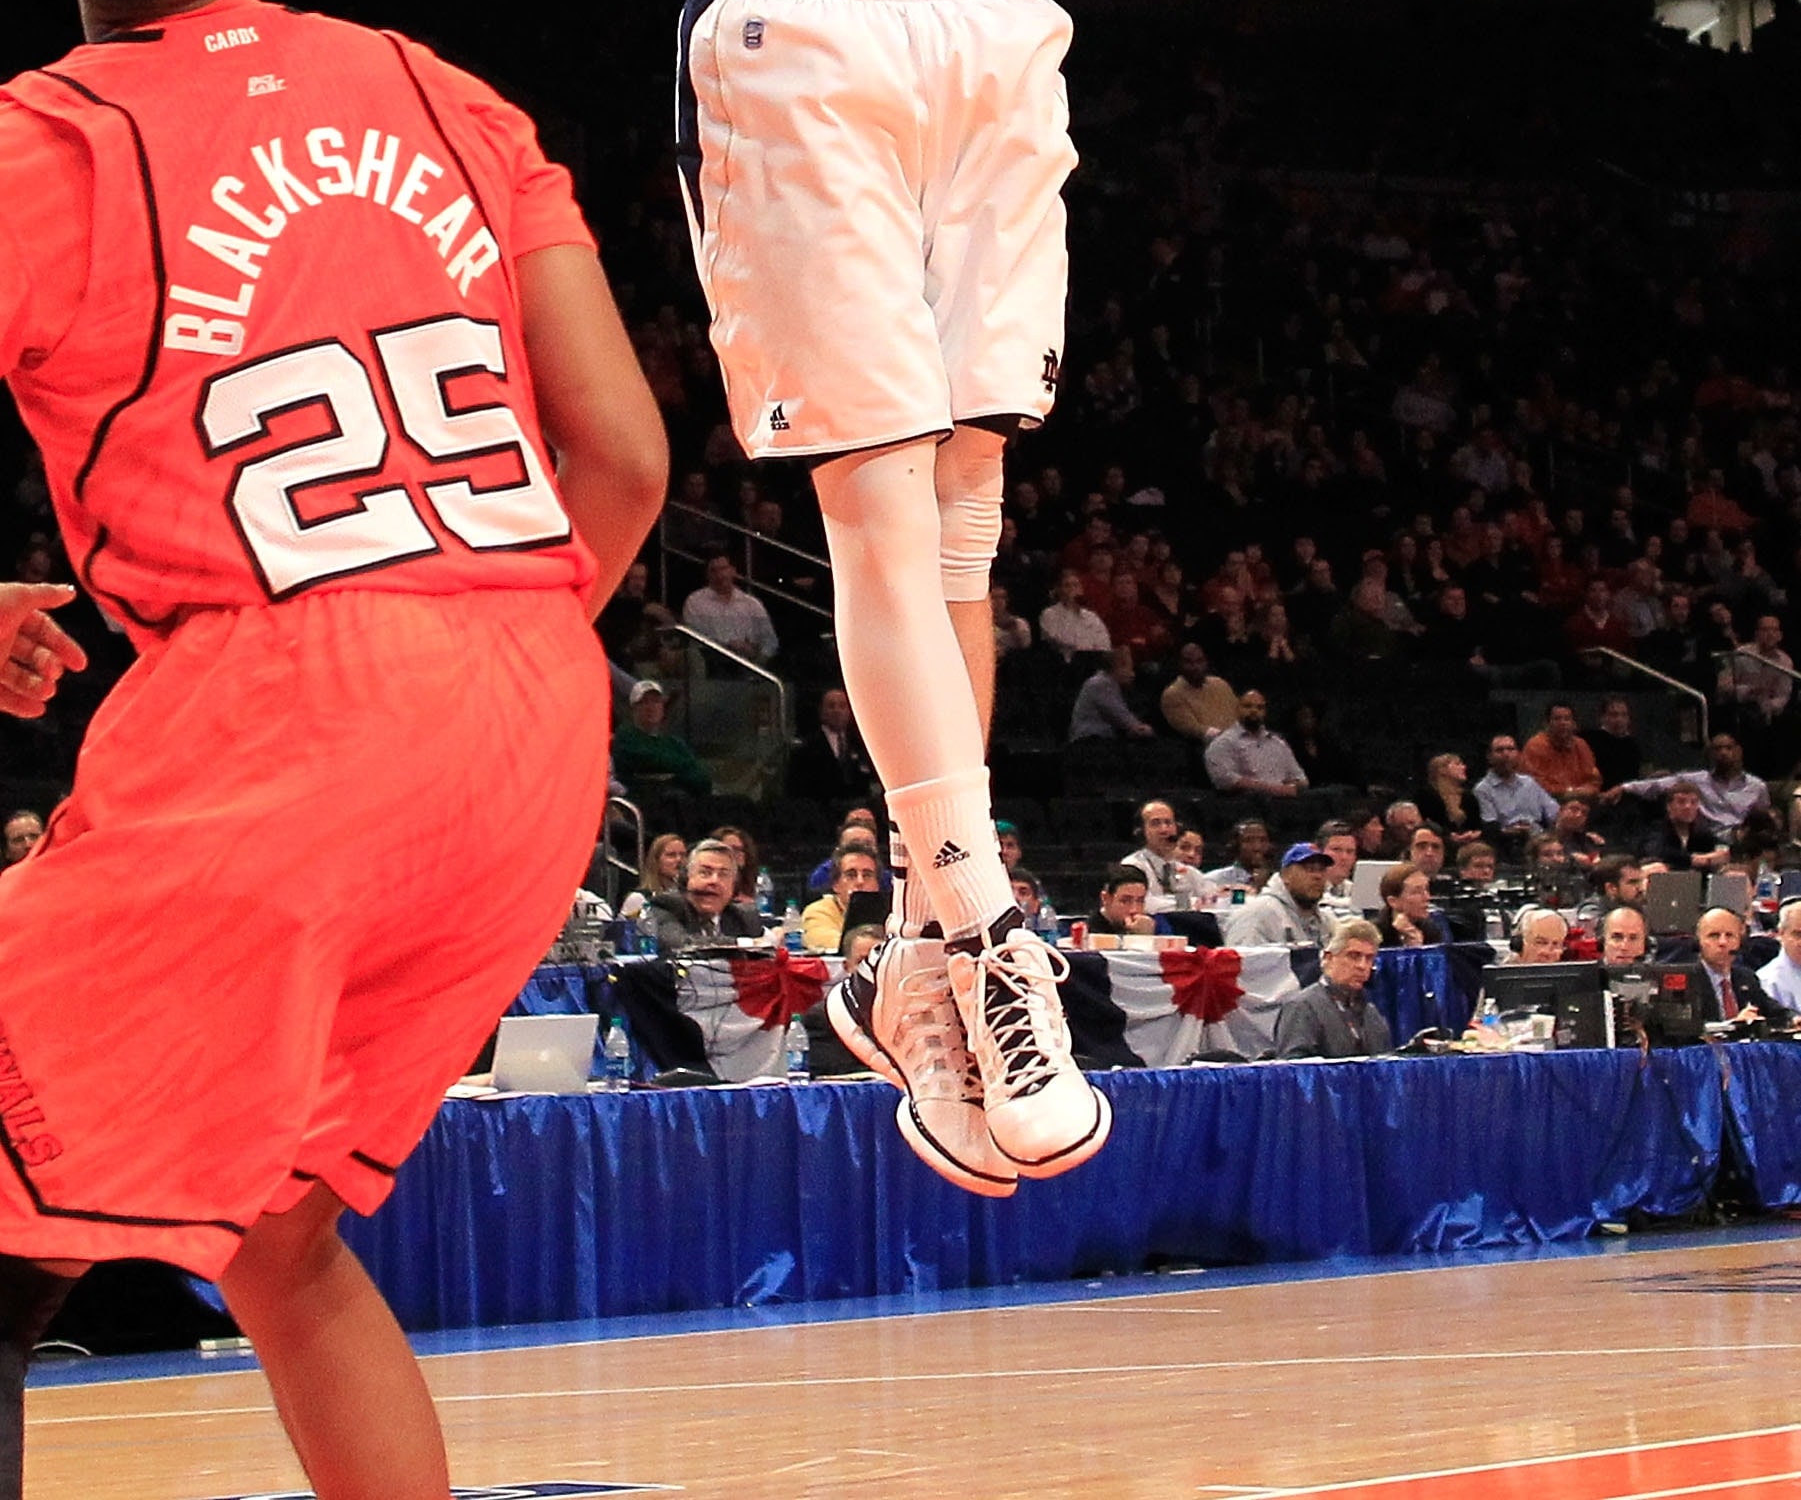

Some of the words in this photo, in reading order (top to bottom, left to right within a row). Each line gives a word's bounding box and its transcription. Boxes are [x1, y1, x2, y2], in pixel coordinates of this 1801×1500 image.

[204, 26, 260, 53] CARDS
[163, 126, 500, 355] BLACKSHEAR
[197, 313, 571, 601] 25
[933, 851, 970, 869] adidas
